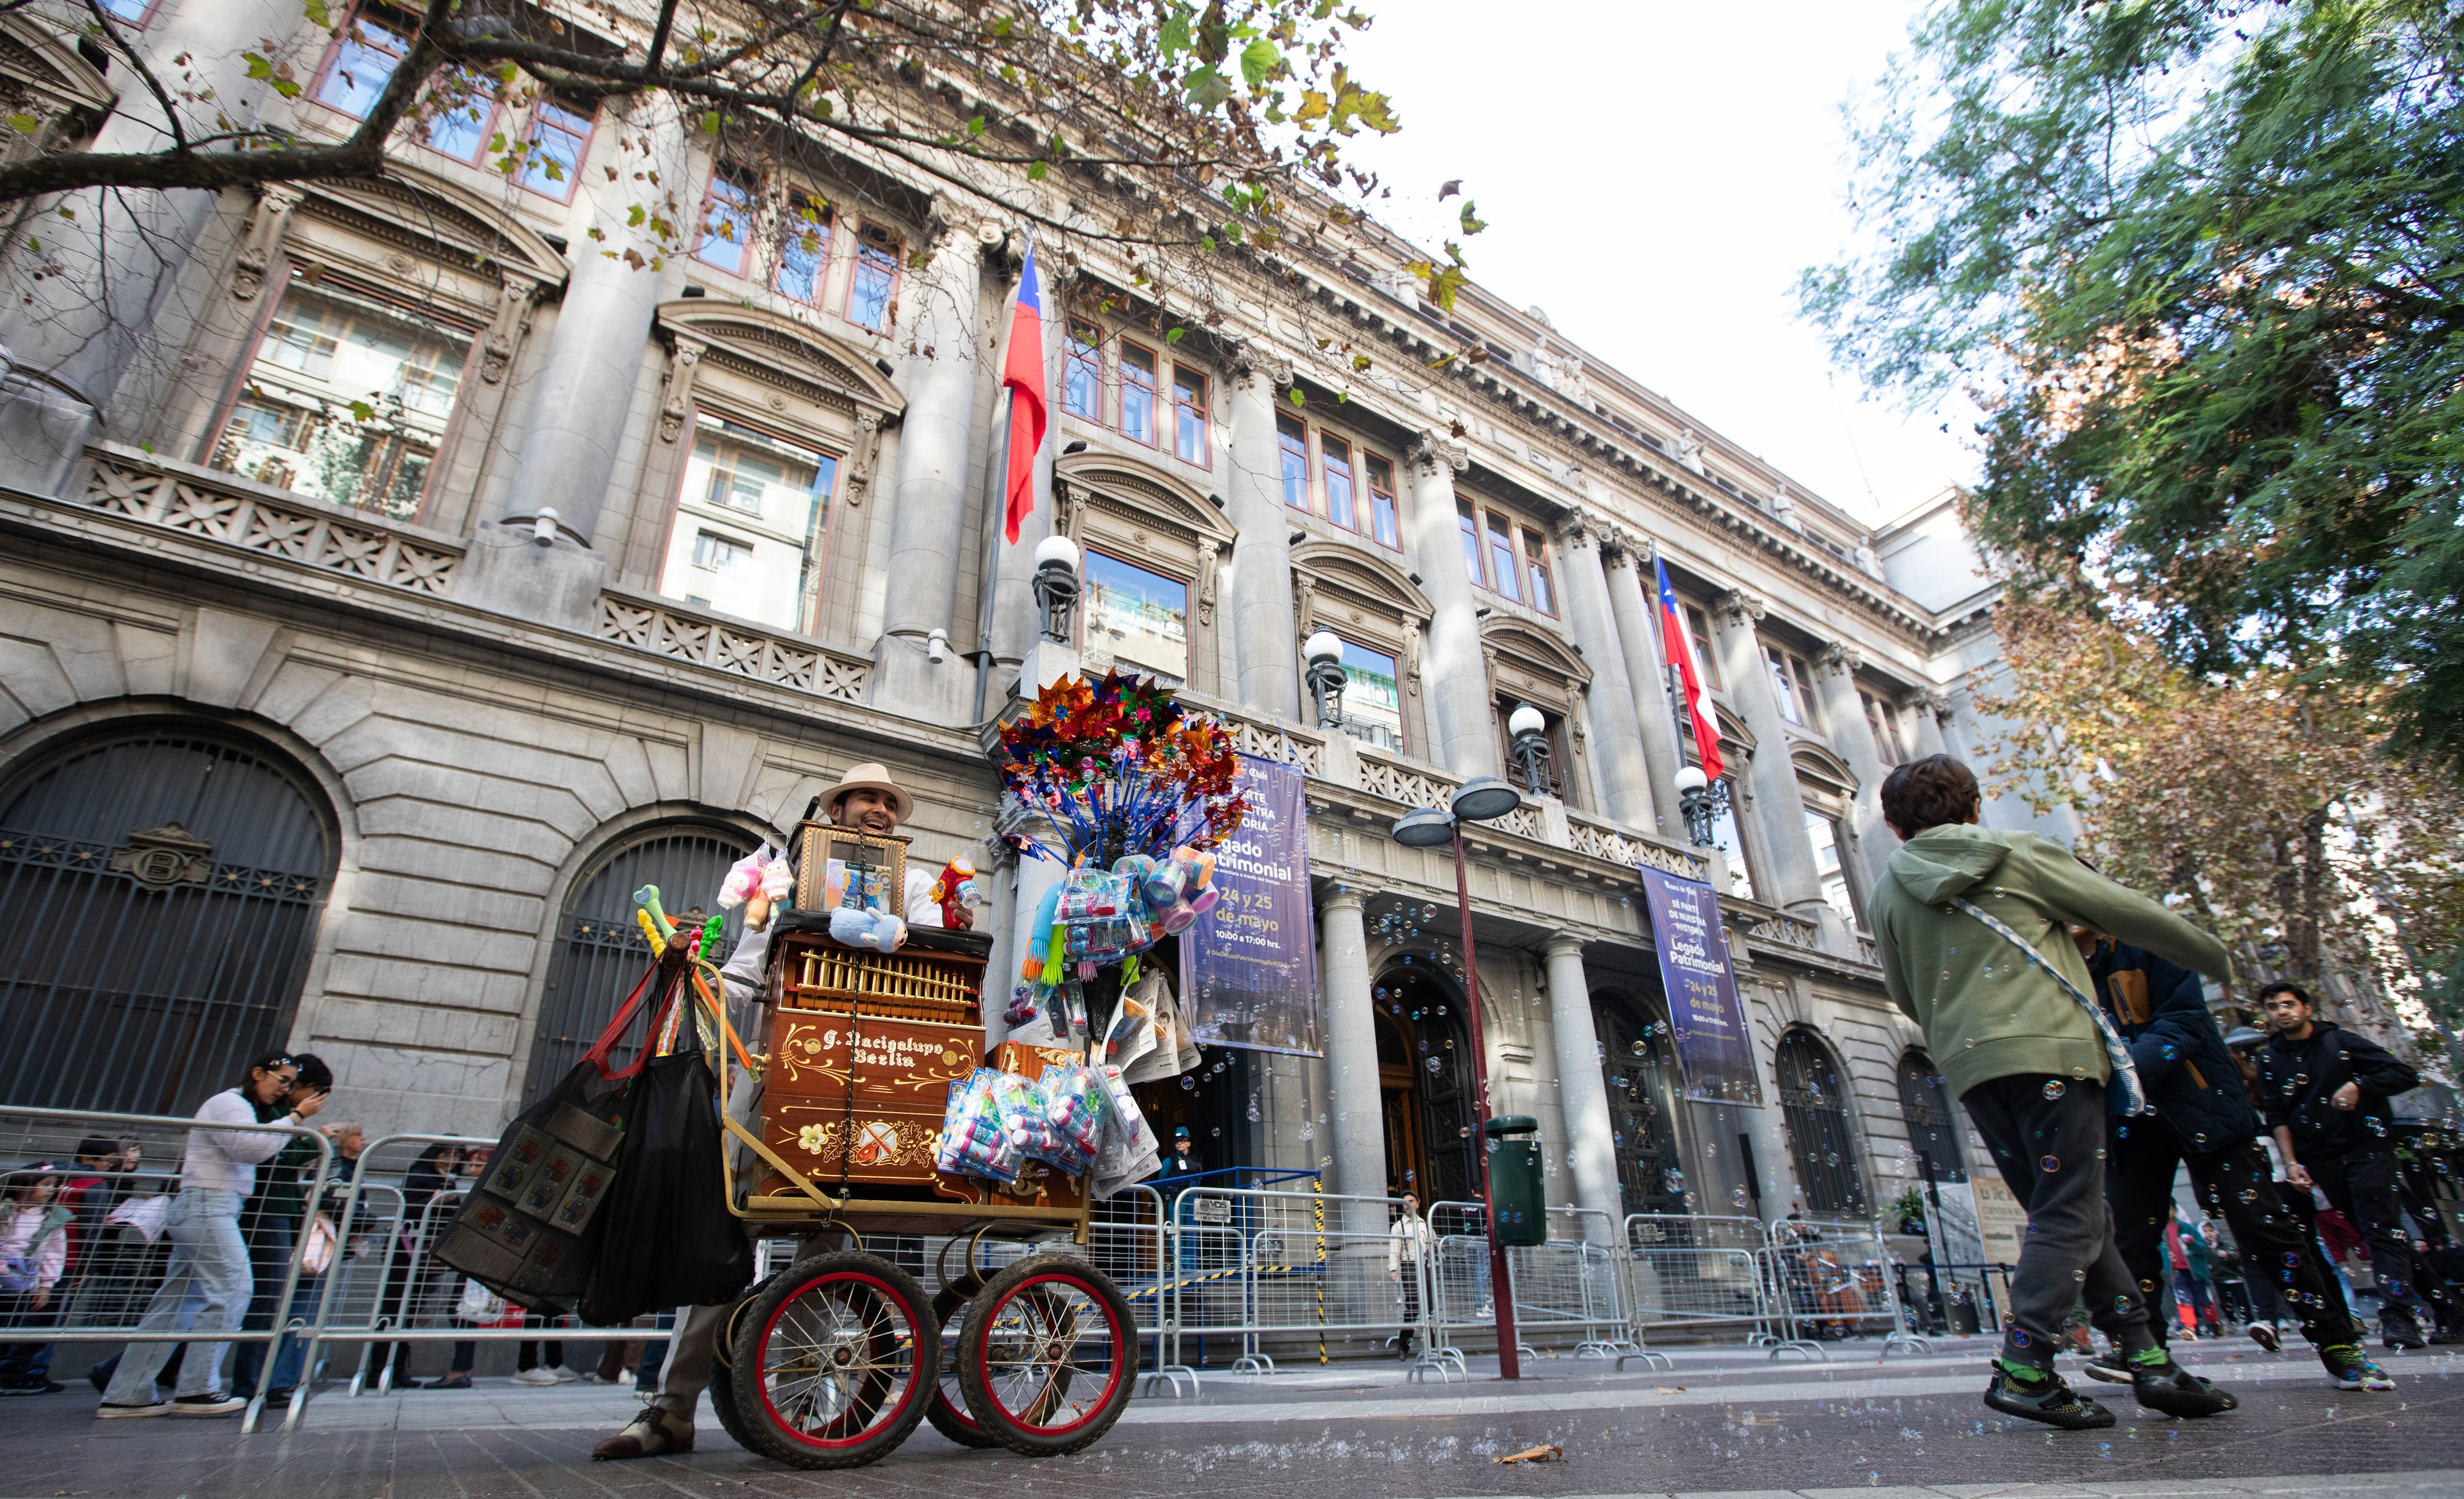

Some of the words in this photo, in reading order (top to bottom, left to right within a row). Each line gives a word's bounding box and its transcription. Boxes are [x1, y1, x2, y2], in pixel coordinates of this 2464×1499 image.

[1249, 768, 1269, 781] Chile
[1204, 850, 1292, 881] atrimonial
[1221, 886, 1240, 903] 24
[1242, 894, 1251, 908] y
[1255, 894, 1272, 910] 25
[1215, 907, 1235, 923] de
[1238, 914, 1279, 933] mayo
[1669, 910, 1679, 919] DE
[1679, 912, 1707, 927] NUESTRA
[1215, 930, 1238, 941] 10:00
[1245, 935, 1266, 946] 17:00
[1267, 939, 1281, 949] hrs.
[1671, 938, 1706, 957] Legado
[1670, 951, 1726, 974] Patrimonial
[1690, 981, 1700, 993] 24
[1702, 986, 1707, 997] y
[1707, 985, 1718, 997] 25
[1690, 997, 1701, 1008] de
[1702, 1000, 1725, 1014] mayo
[823, 1030, 841, 1050] G.
[845, 1031, 943, 1056] Bacigalupo
[854, 1048, 916, 1068] Berlin
